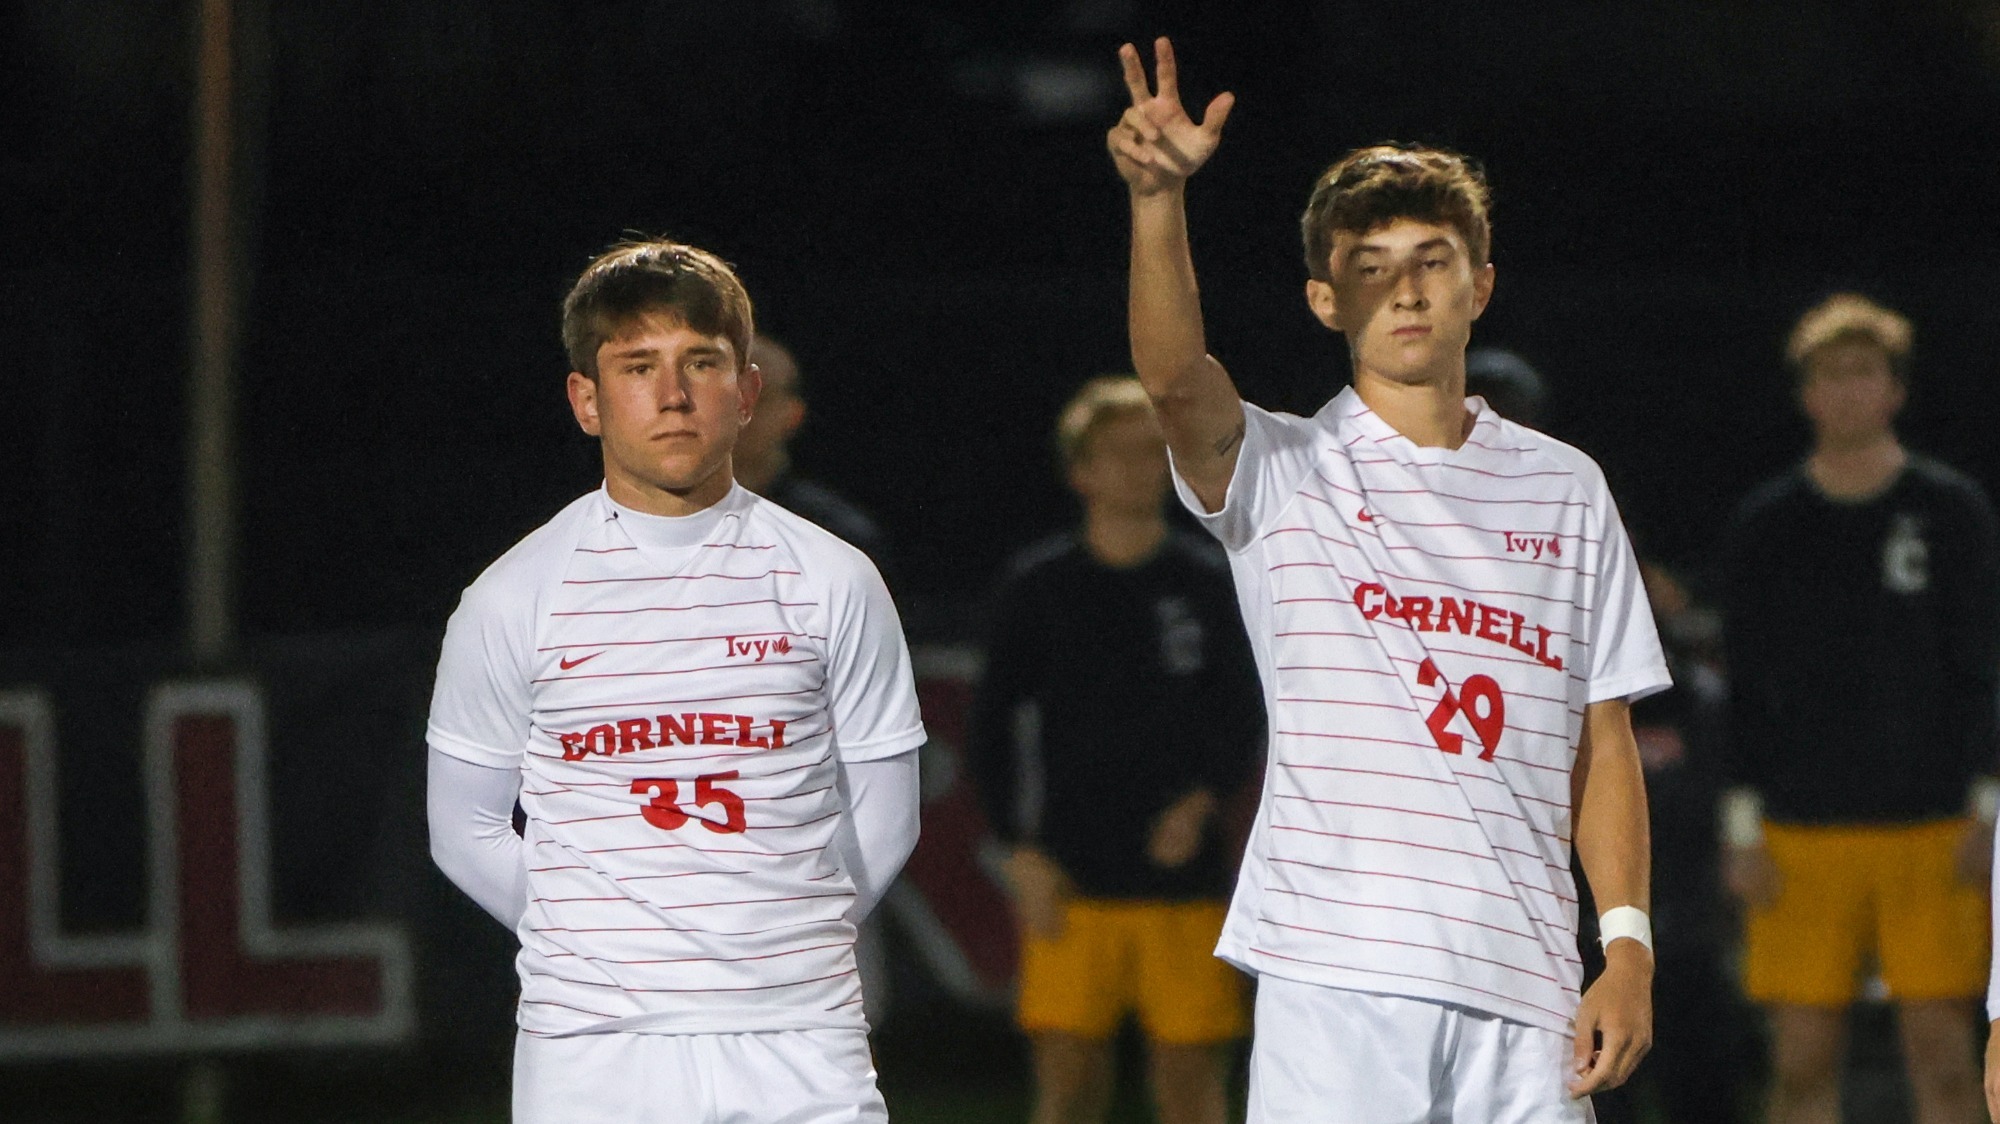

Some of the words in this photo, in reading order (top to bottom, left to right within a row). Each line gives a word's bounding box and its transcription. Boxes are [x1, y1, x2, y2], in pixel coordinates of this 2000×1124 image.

[1504, 531, 1545, 560] Ivy
[725, 635, 770, 662] Ivy
[1417, 656, 1505, 763] 29
[630, 769, 747, 835] 35
